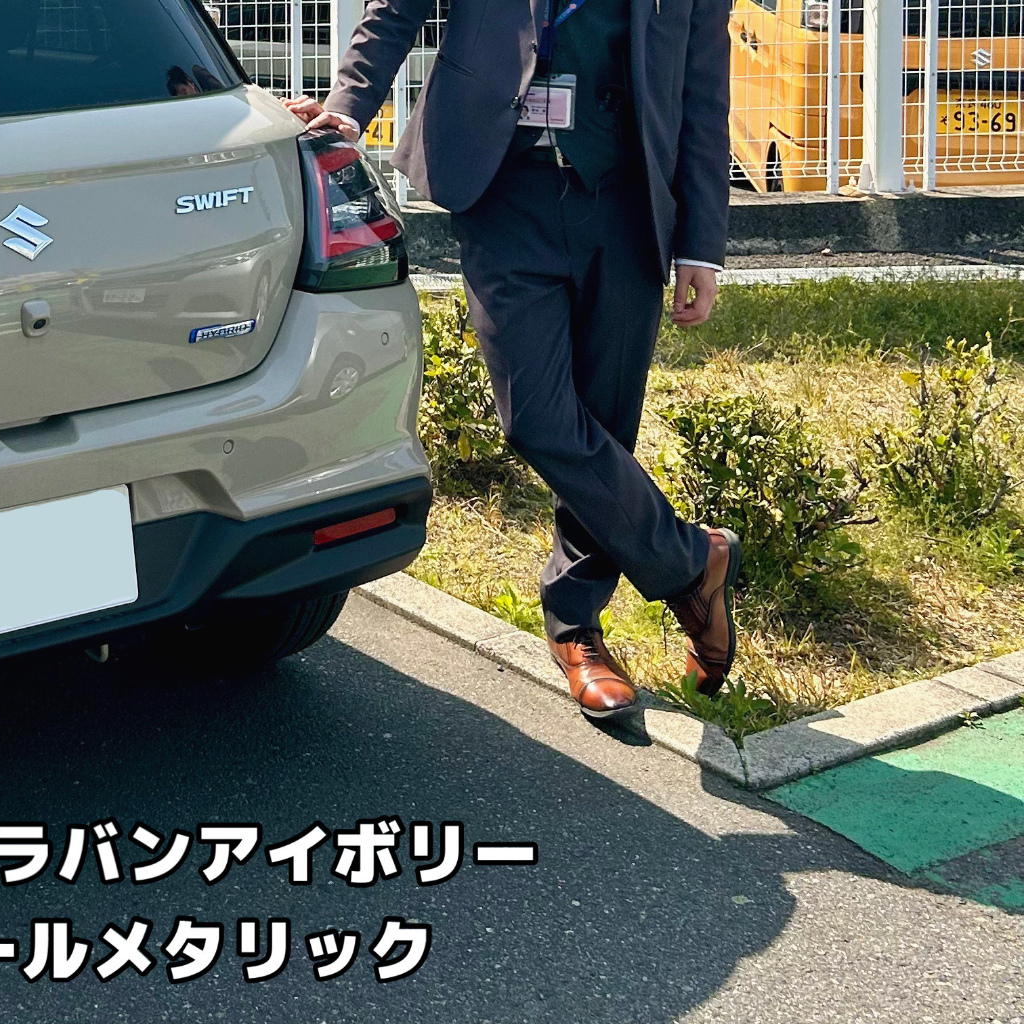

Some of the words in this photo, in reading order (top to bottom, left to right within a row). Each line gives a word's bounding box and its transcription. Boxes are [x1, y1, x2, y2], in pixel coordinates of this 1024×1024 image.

[953, 111, 1017, 133] 93-69
[176, 186, 255, 214] SWIFT
[201, 323, 250, 339] HYBRID
